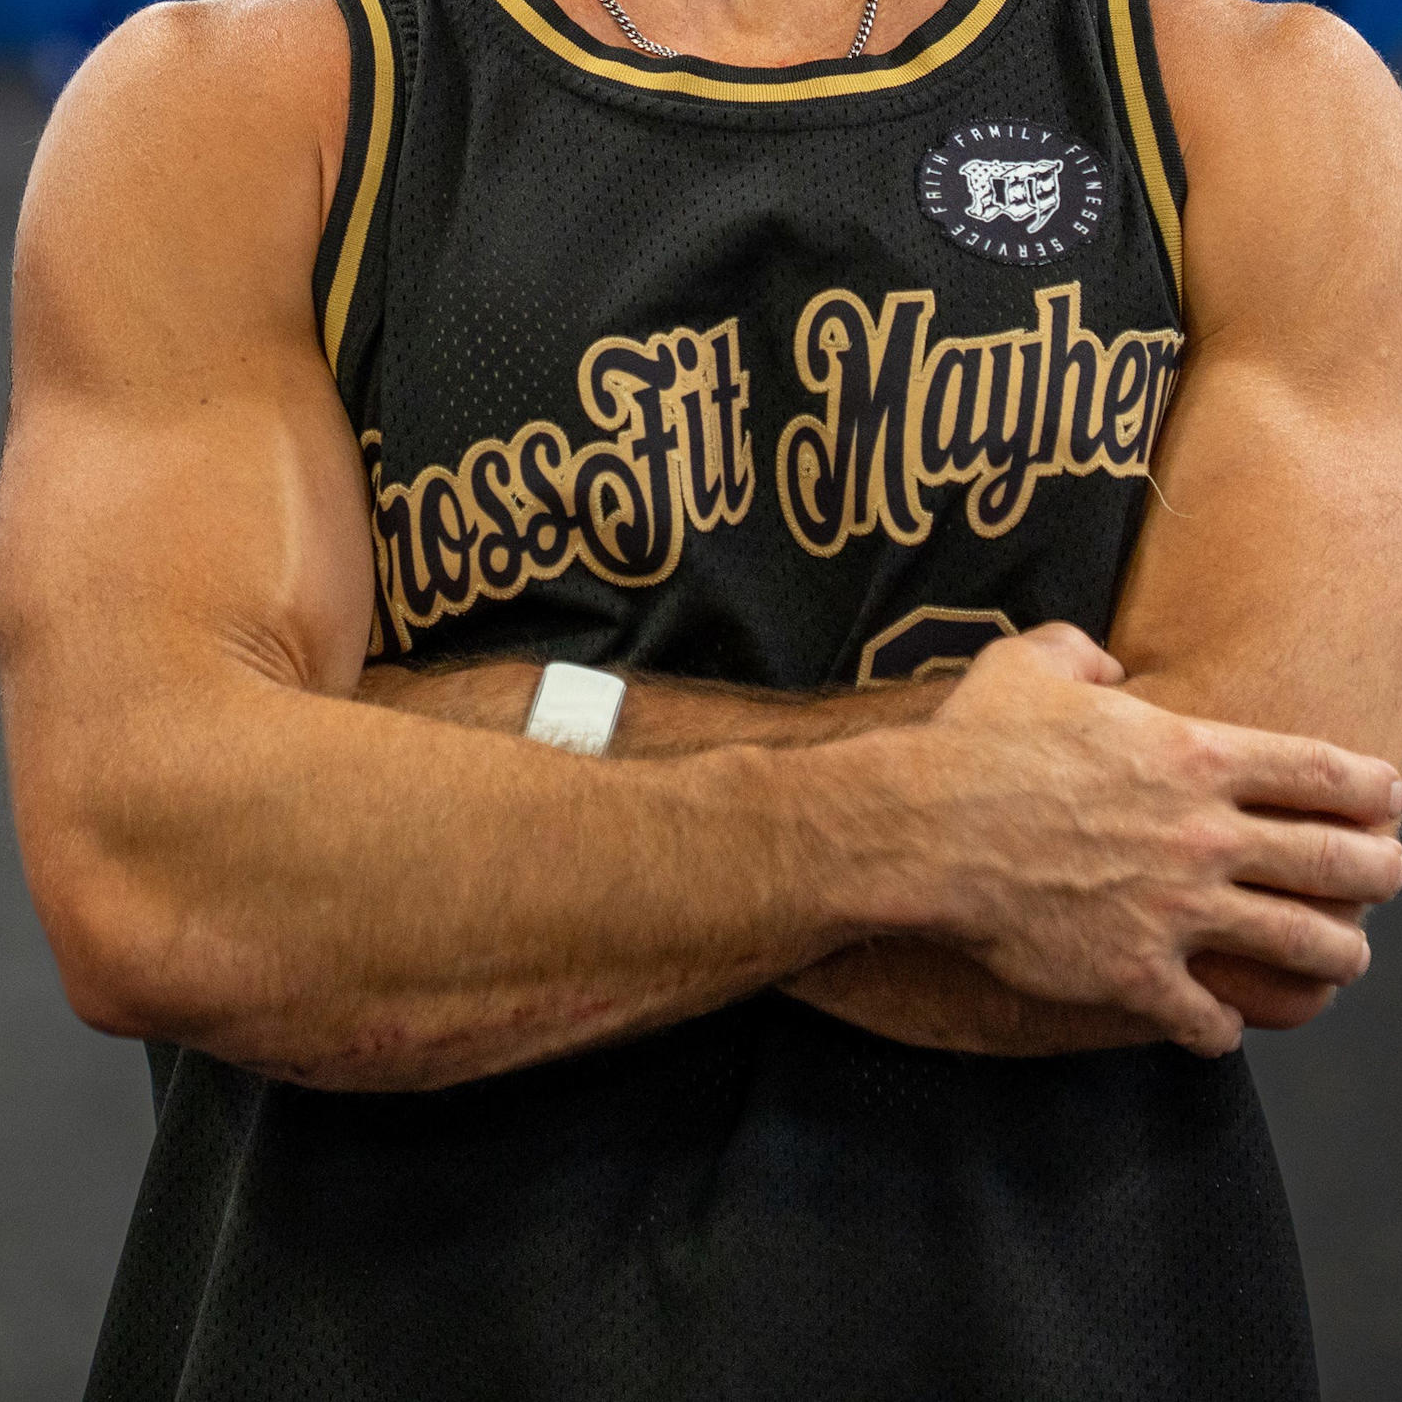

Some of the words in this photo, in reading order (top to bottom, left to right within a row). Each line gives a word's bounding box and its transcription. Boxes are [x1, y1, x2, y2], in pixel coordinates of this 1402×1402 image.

[953, 125, 1052, 148] FAMILY
[925, 153, 949, 214] FAITH
[1065, 145, 1103, 235] FITNESS
[951, 224, 1065, 258] SERVICE
[360, 317, 756, 656] rossFit
